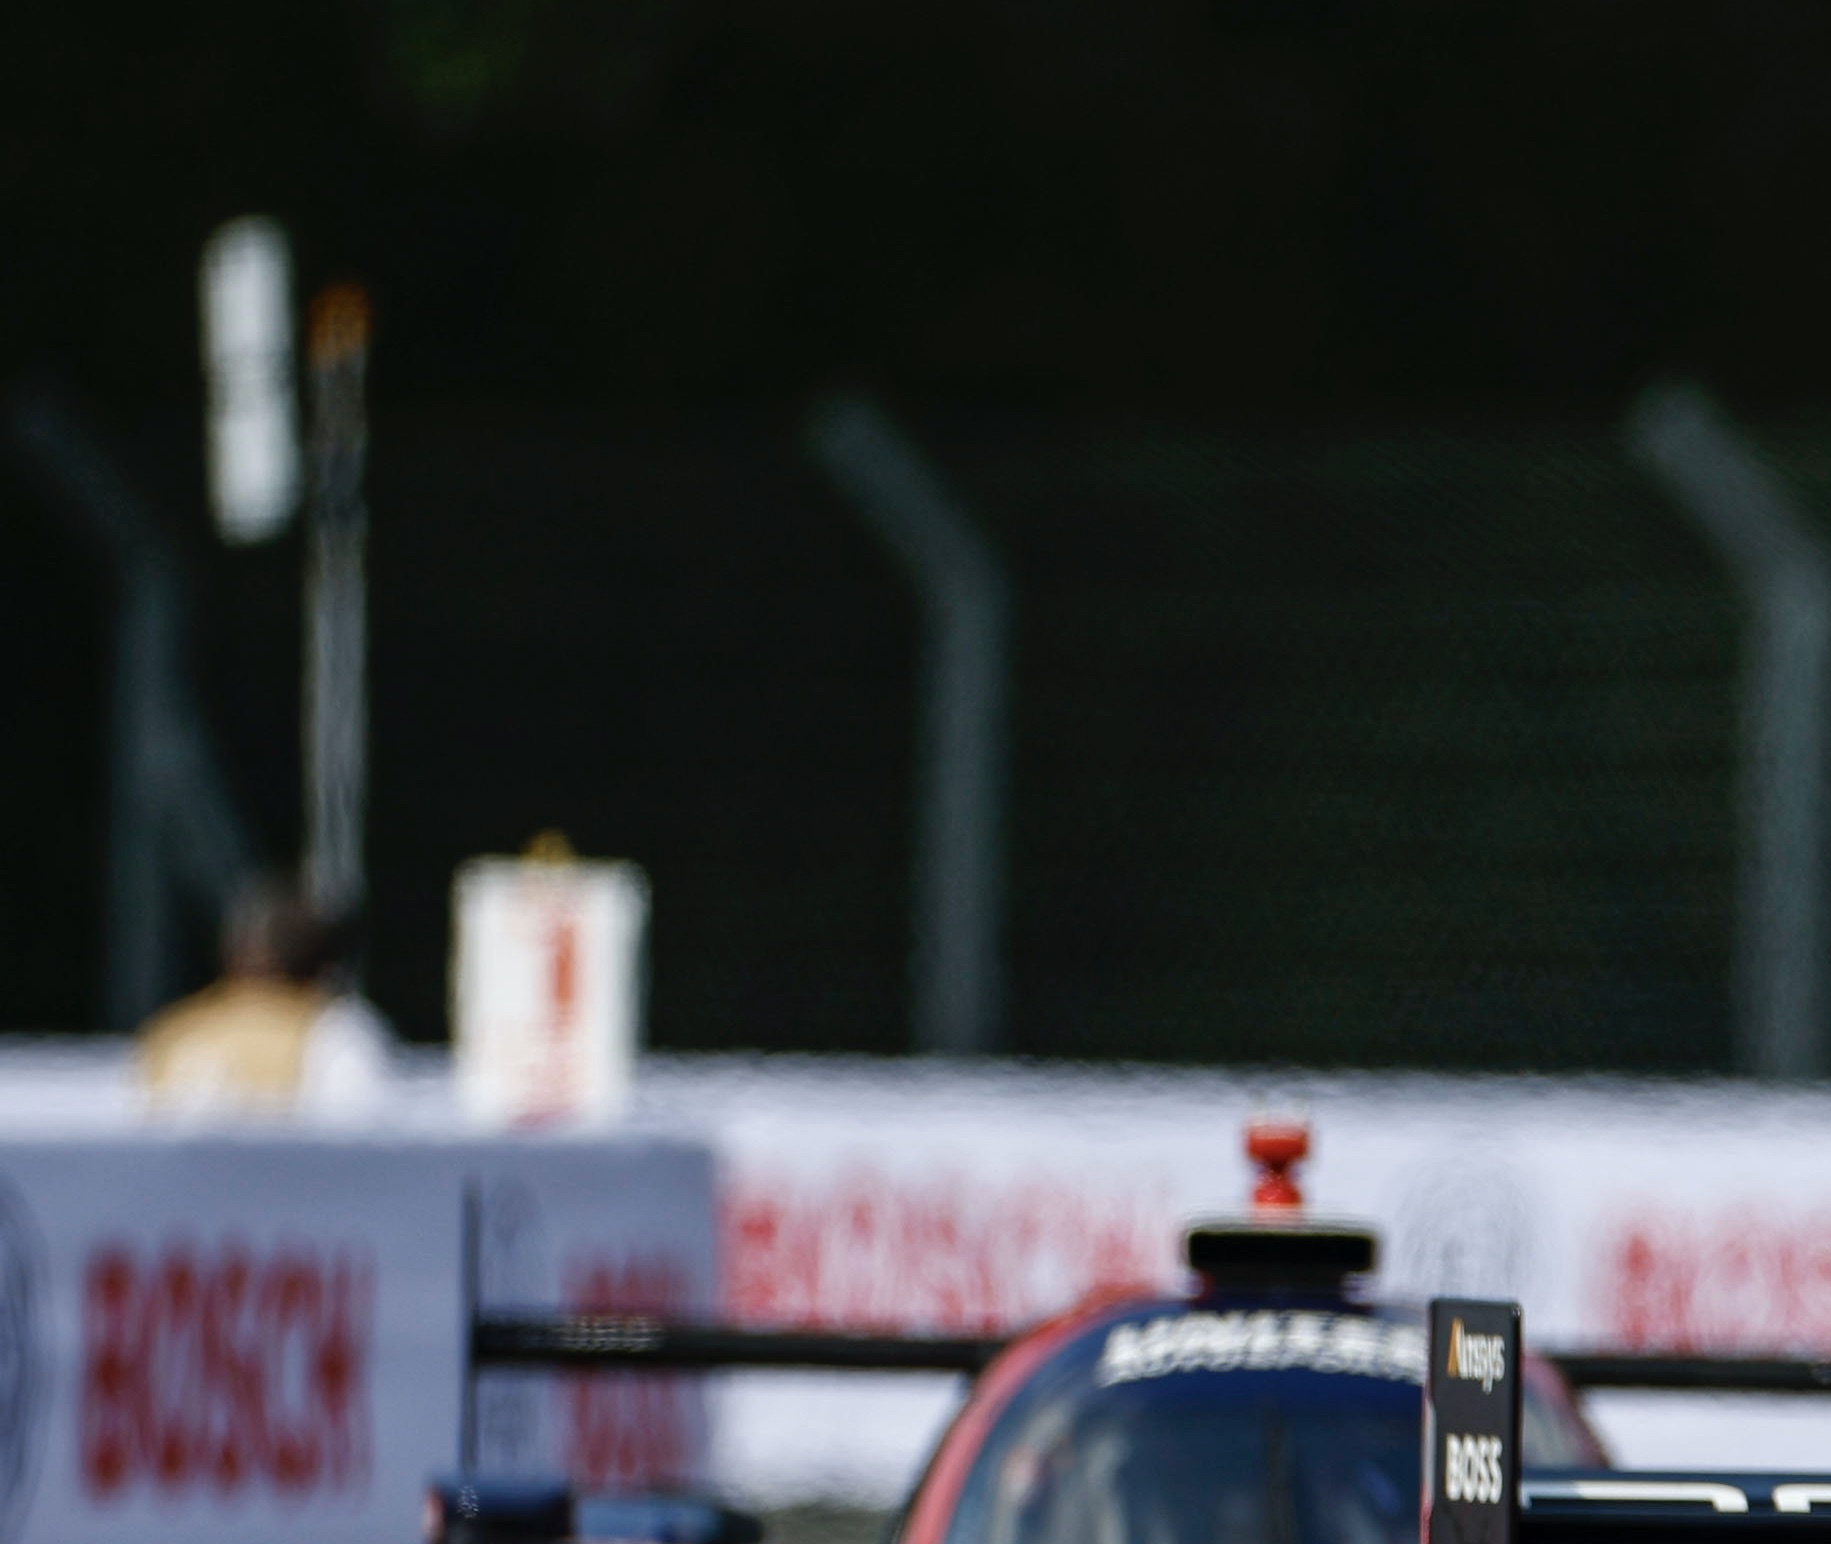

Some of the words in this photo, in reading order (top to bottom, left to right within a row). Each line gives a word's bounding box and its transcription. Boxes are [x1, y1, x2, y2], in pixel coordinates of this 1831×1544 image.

[80, 1238, 374, 1502] BOSCH
[1447, 1317, 1504, 1393] Ansys
[1446, 1433, 1502, 1503] BOSS
